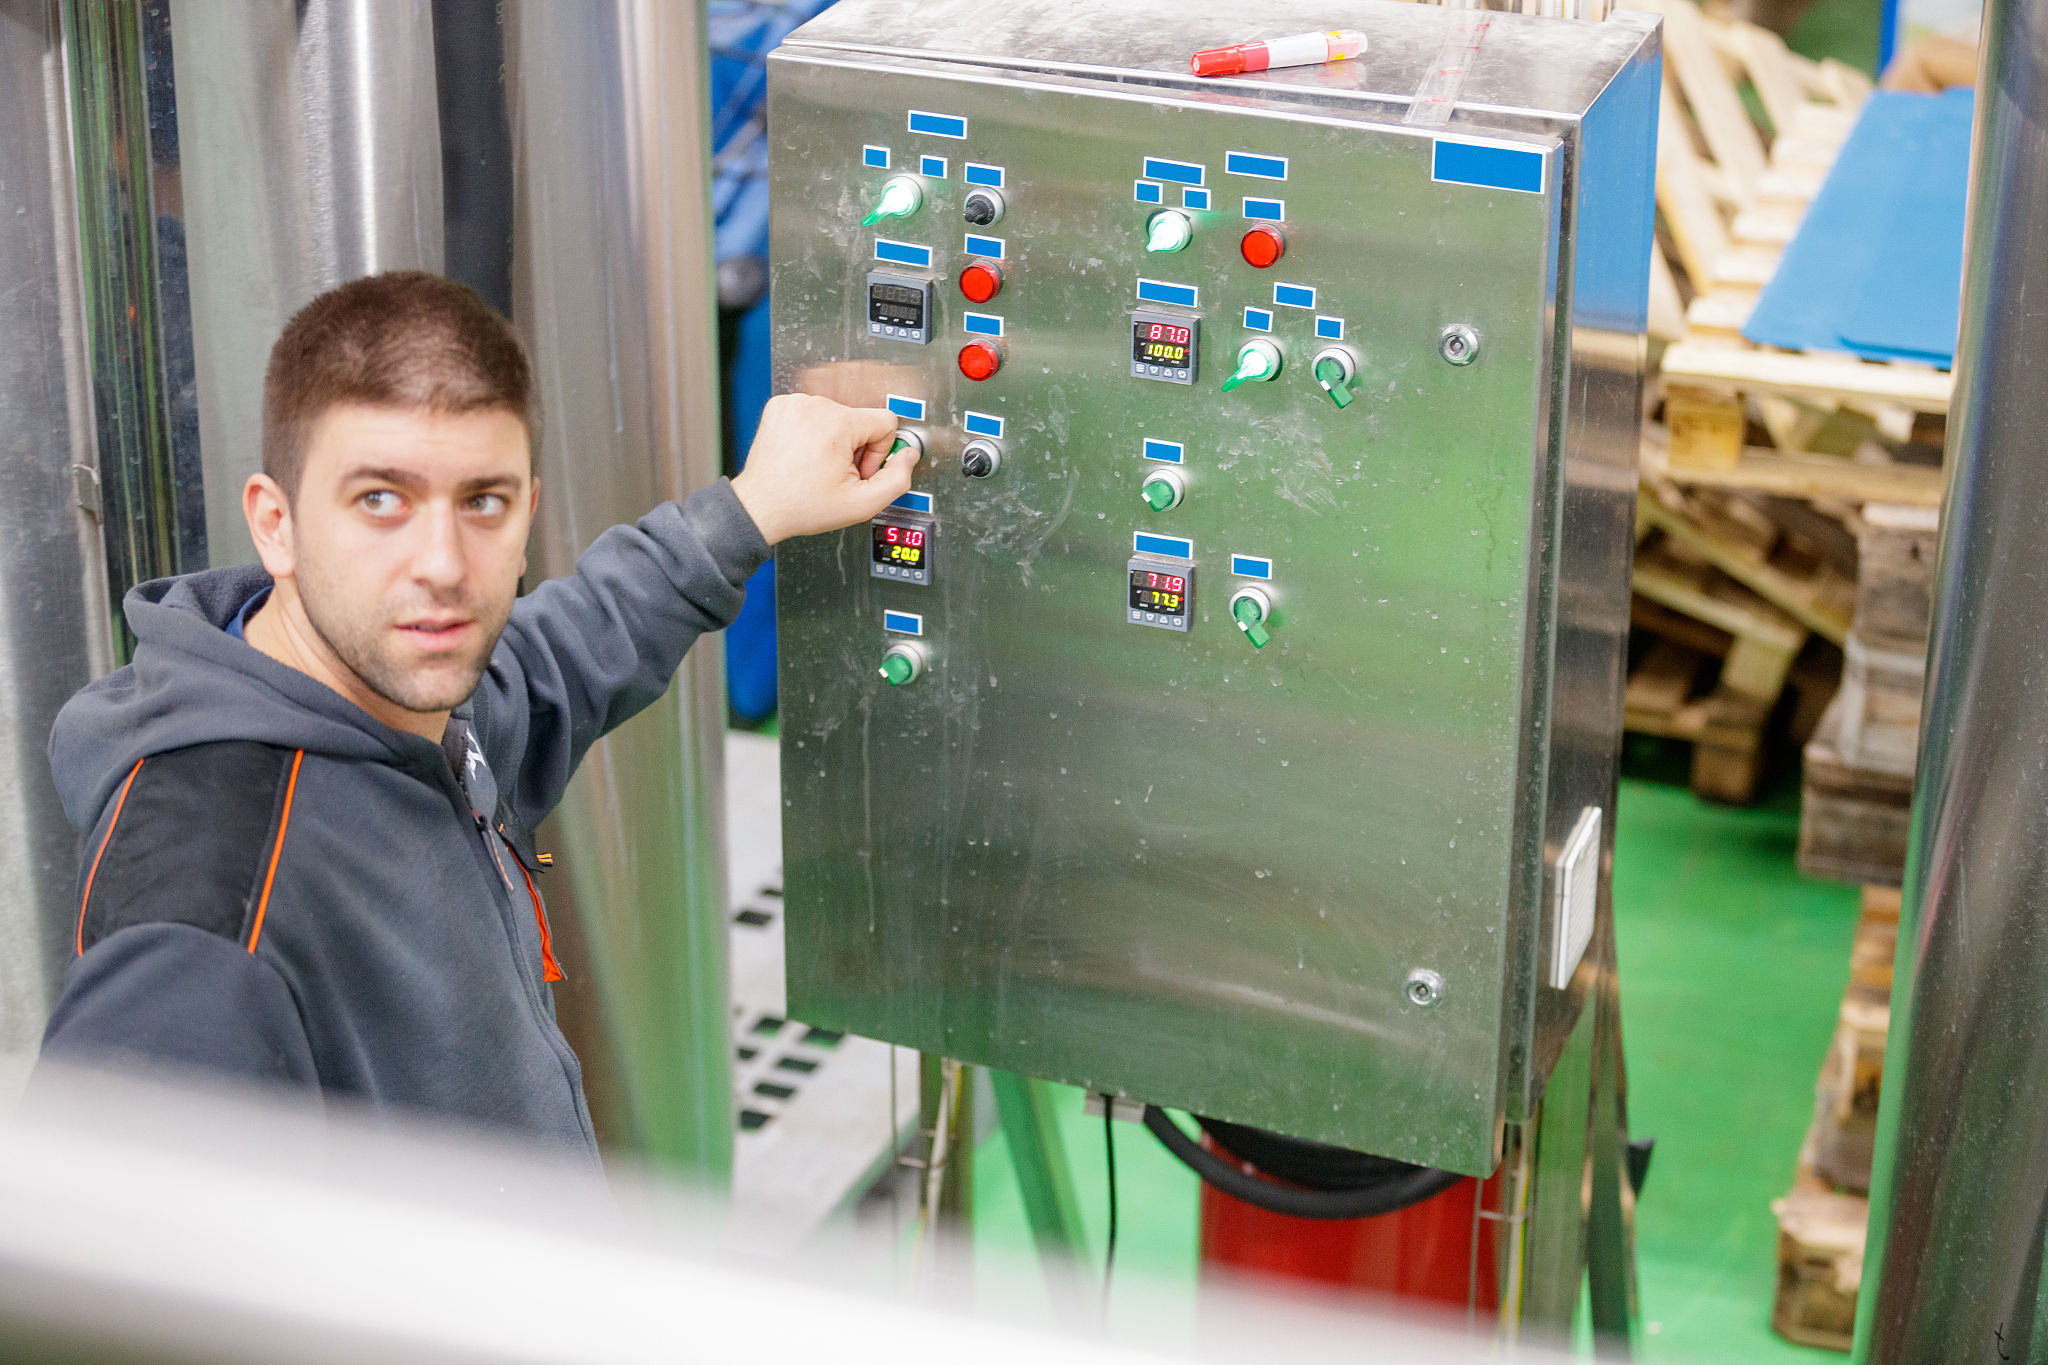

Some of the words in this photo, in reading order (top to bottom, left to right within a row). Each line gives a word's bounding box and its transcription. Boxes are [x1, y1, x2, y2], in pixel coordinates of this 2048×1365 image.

[1150, 324, 1189, 344] 87.0
[1148, 344, 1184, 360] 100.0
[886, 527, 923, 547] 51.0
[891, 546, 920, 562] 20.0
[1148, 572, 1184, 592] 71.9
[1152, 591, 1179, 607] 77.3
